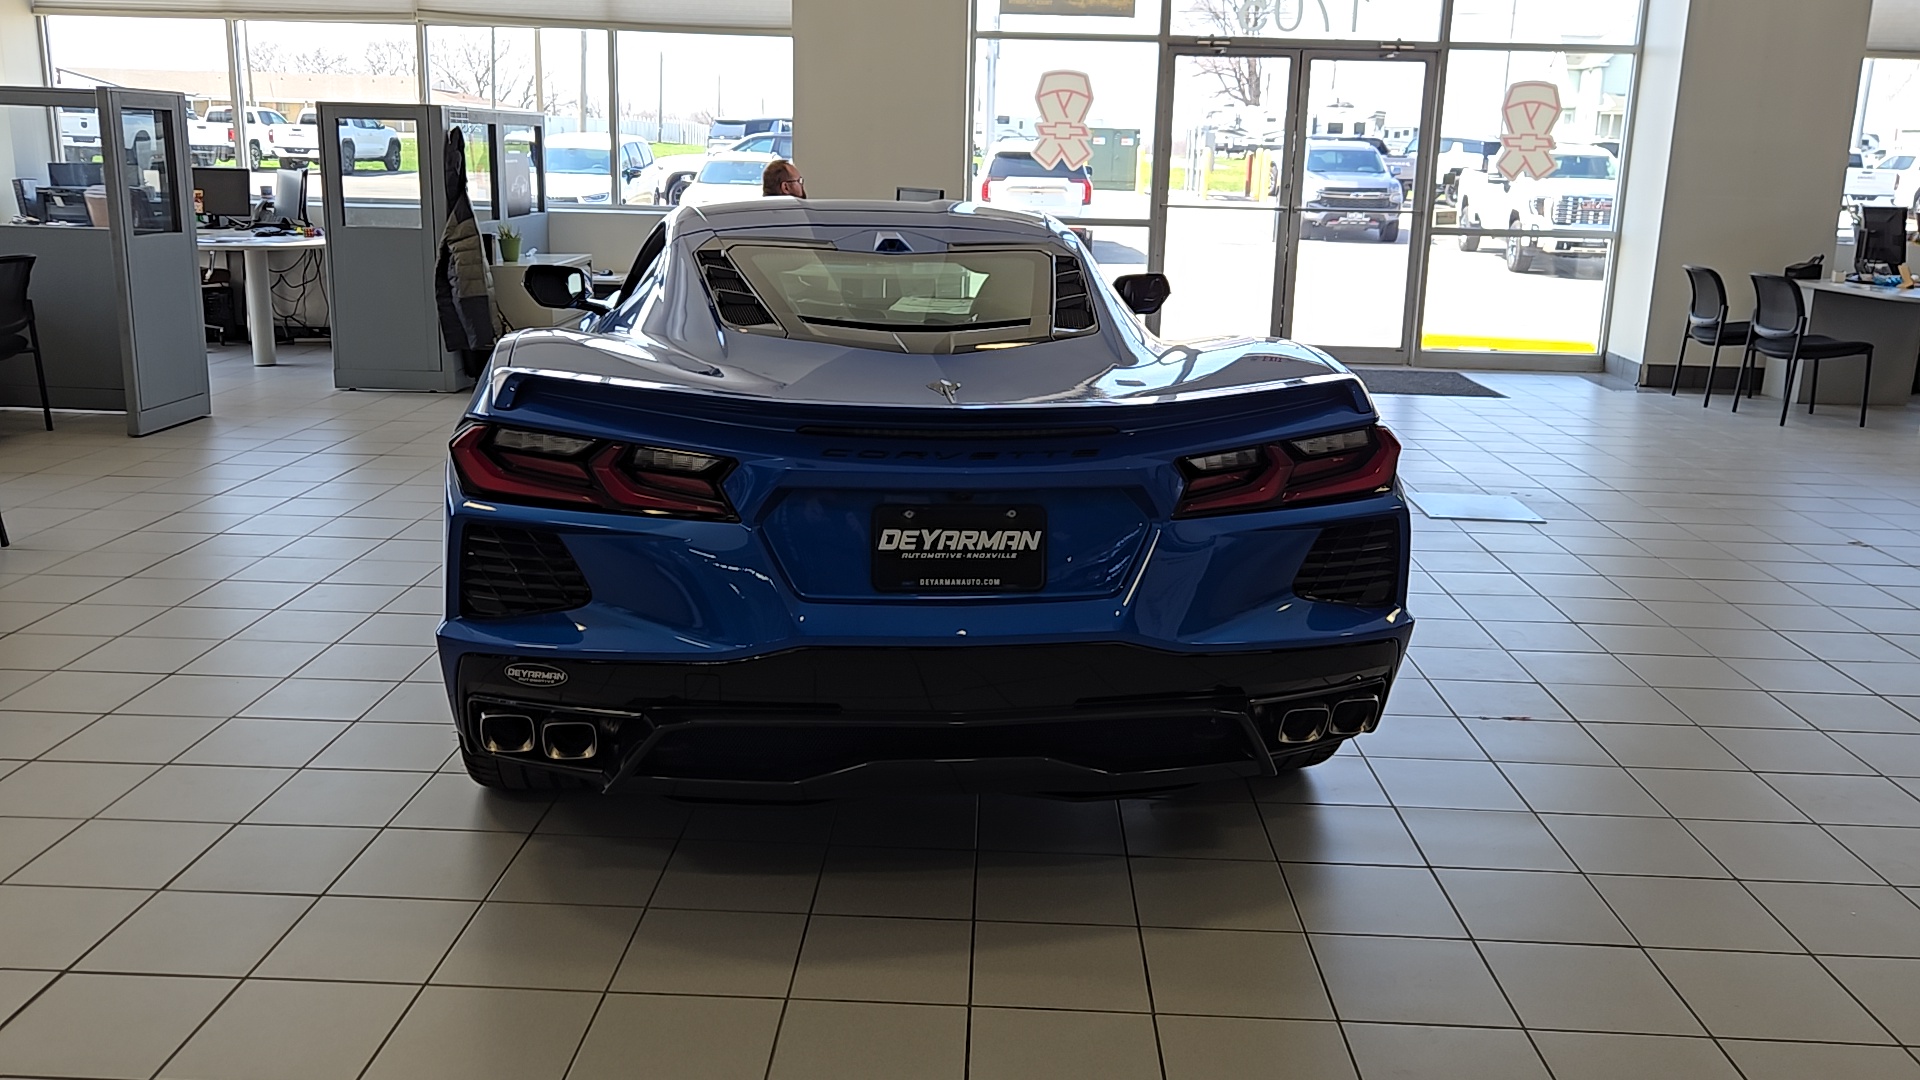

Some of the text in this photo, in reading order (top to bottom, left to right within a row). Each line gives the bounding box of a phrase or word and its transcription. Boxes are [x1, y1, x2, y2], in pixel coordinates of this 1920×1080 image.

[821, 447, 1101, 461] CORVETTE
[878, 528, 1043, 551] DEYARMAN
[919, 578, 1001, 586] DEYARMANAUTO.COM
[508, 668, 565, 681] DEYARMAN
